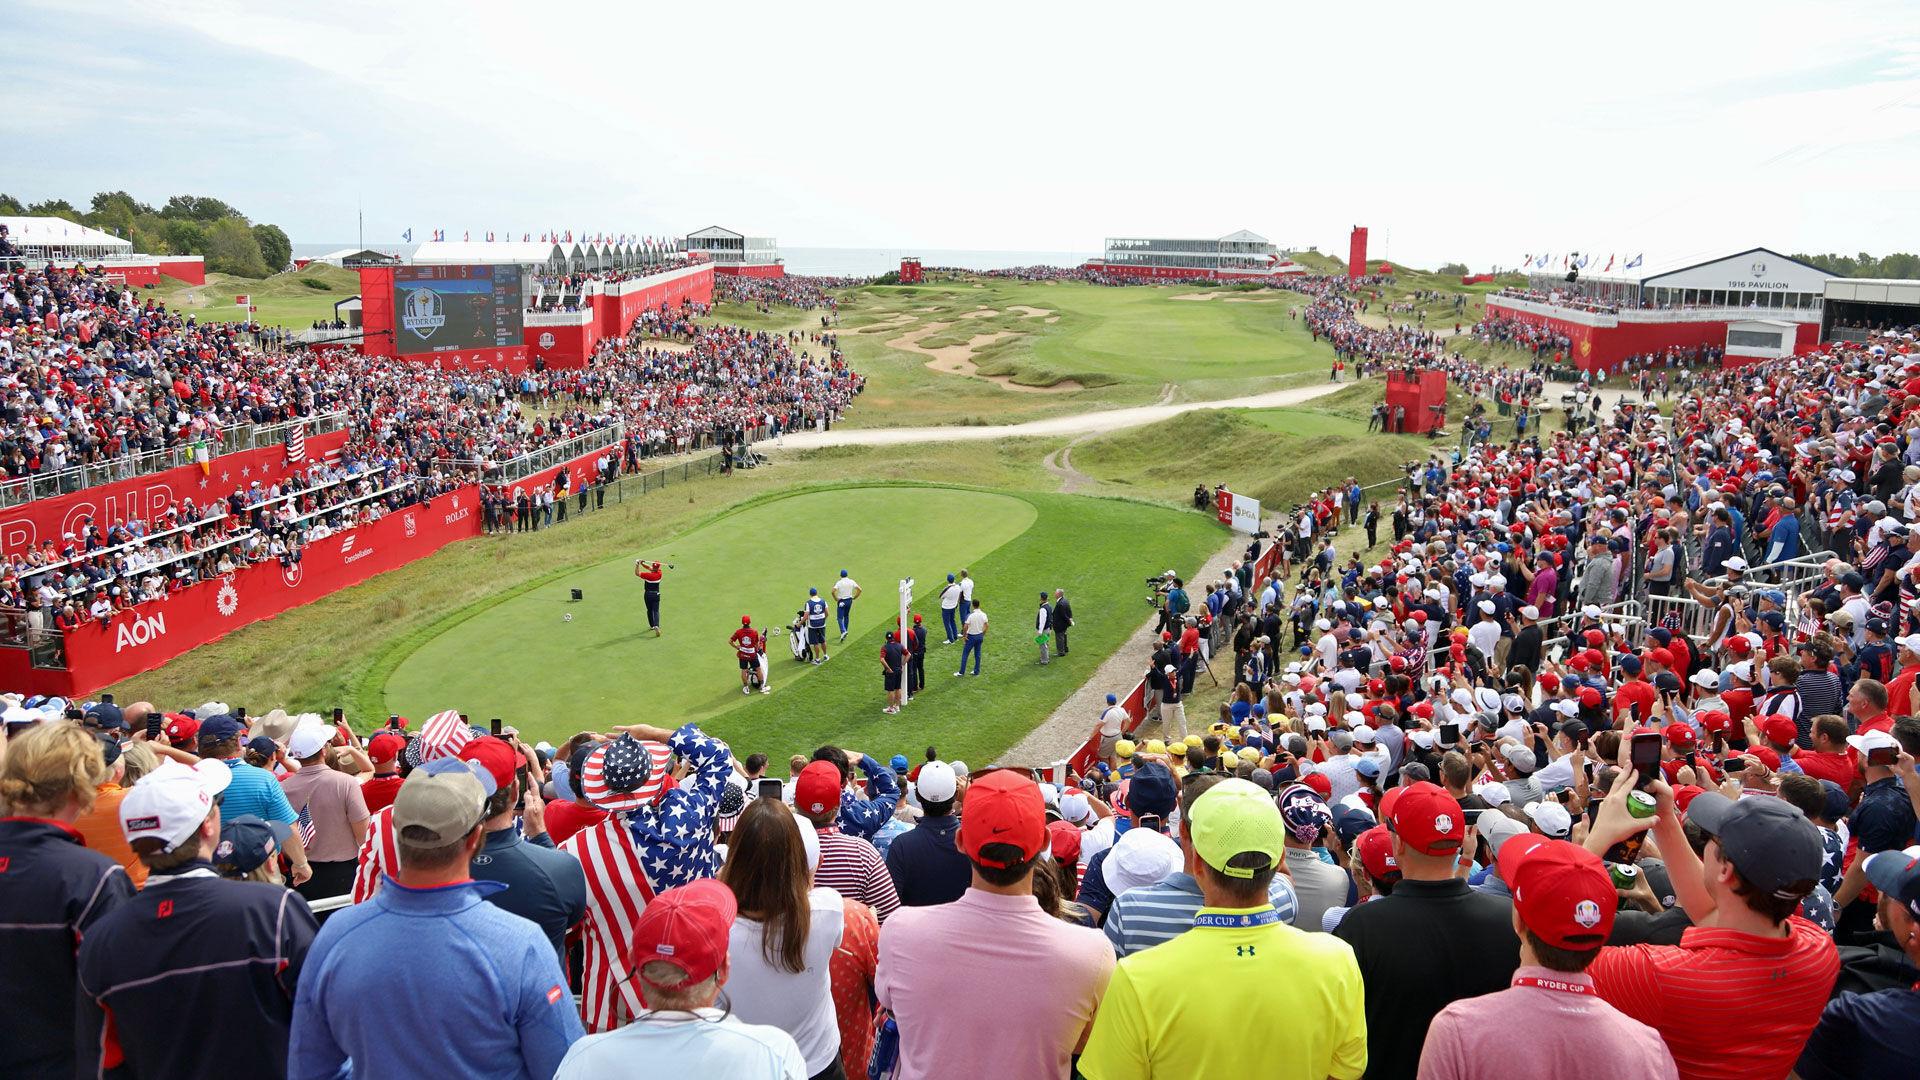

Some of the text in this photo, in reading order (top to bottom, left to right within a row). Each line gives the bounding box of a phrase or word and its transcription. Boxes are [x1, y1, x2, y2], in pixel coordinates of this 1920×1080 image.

[438, 266, 447, 278] 11
[1748, 281, 1789, 289] PAVILION
[429, 317, 443, 325] CUP
[445, 507, 470, 525] ROLEX
[1241, 508, 1256, 520] PGA
[344, 547, 374, 564] Constellation
[115, 611, 167, 653] AON
[1215, 916, 1235, 926] CUP
[1537, 979, 1584, 993] RYDER CUP
